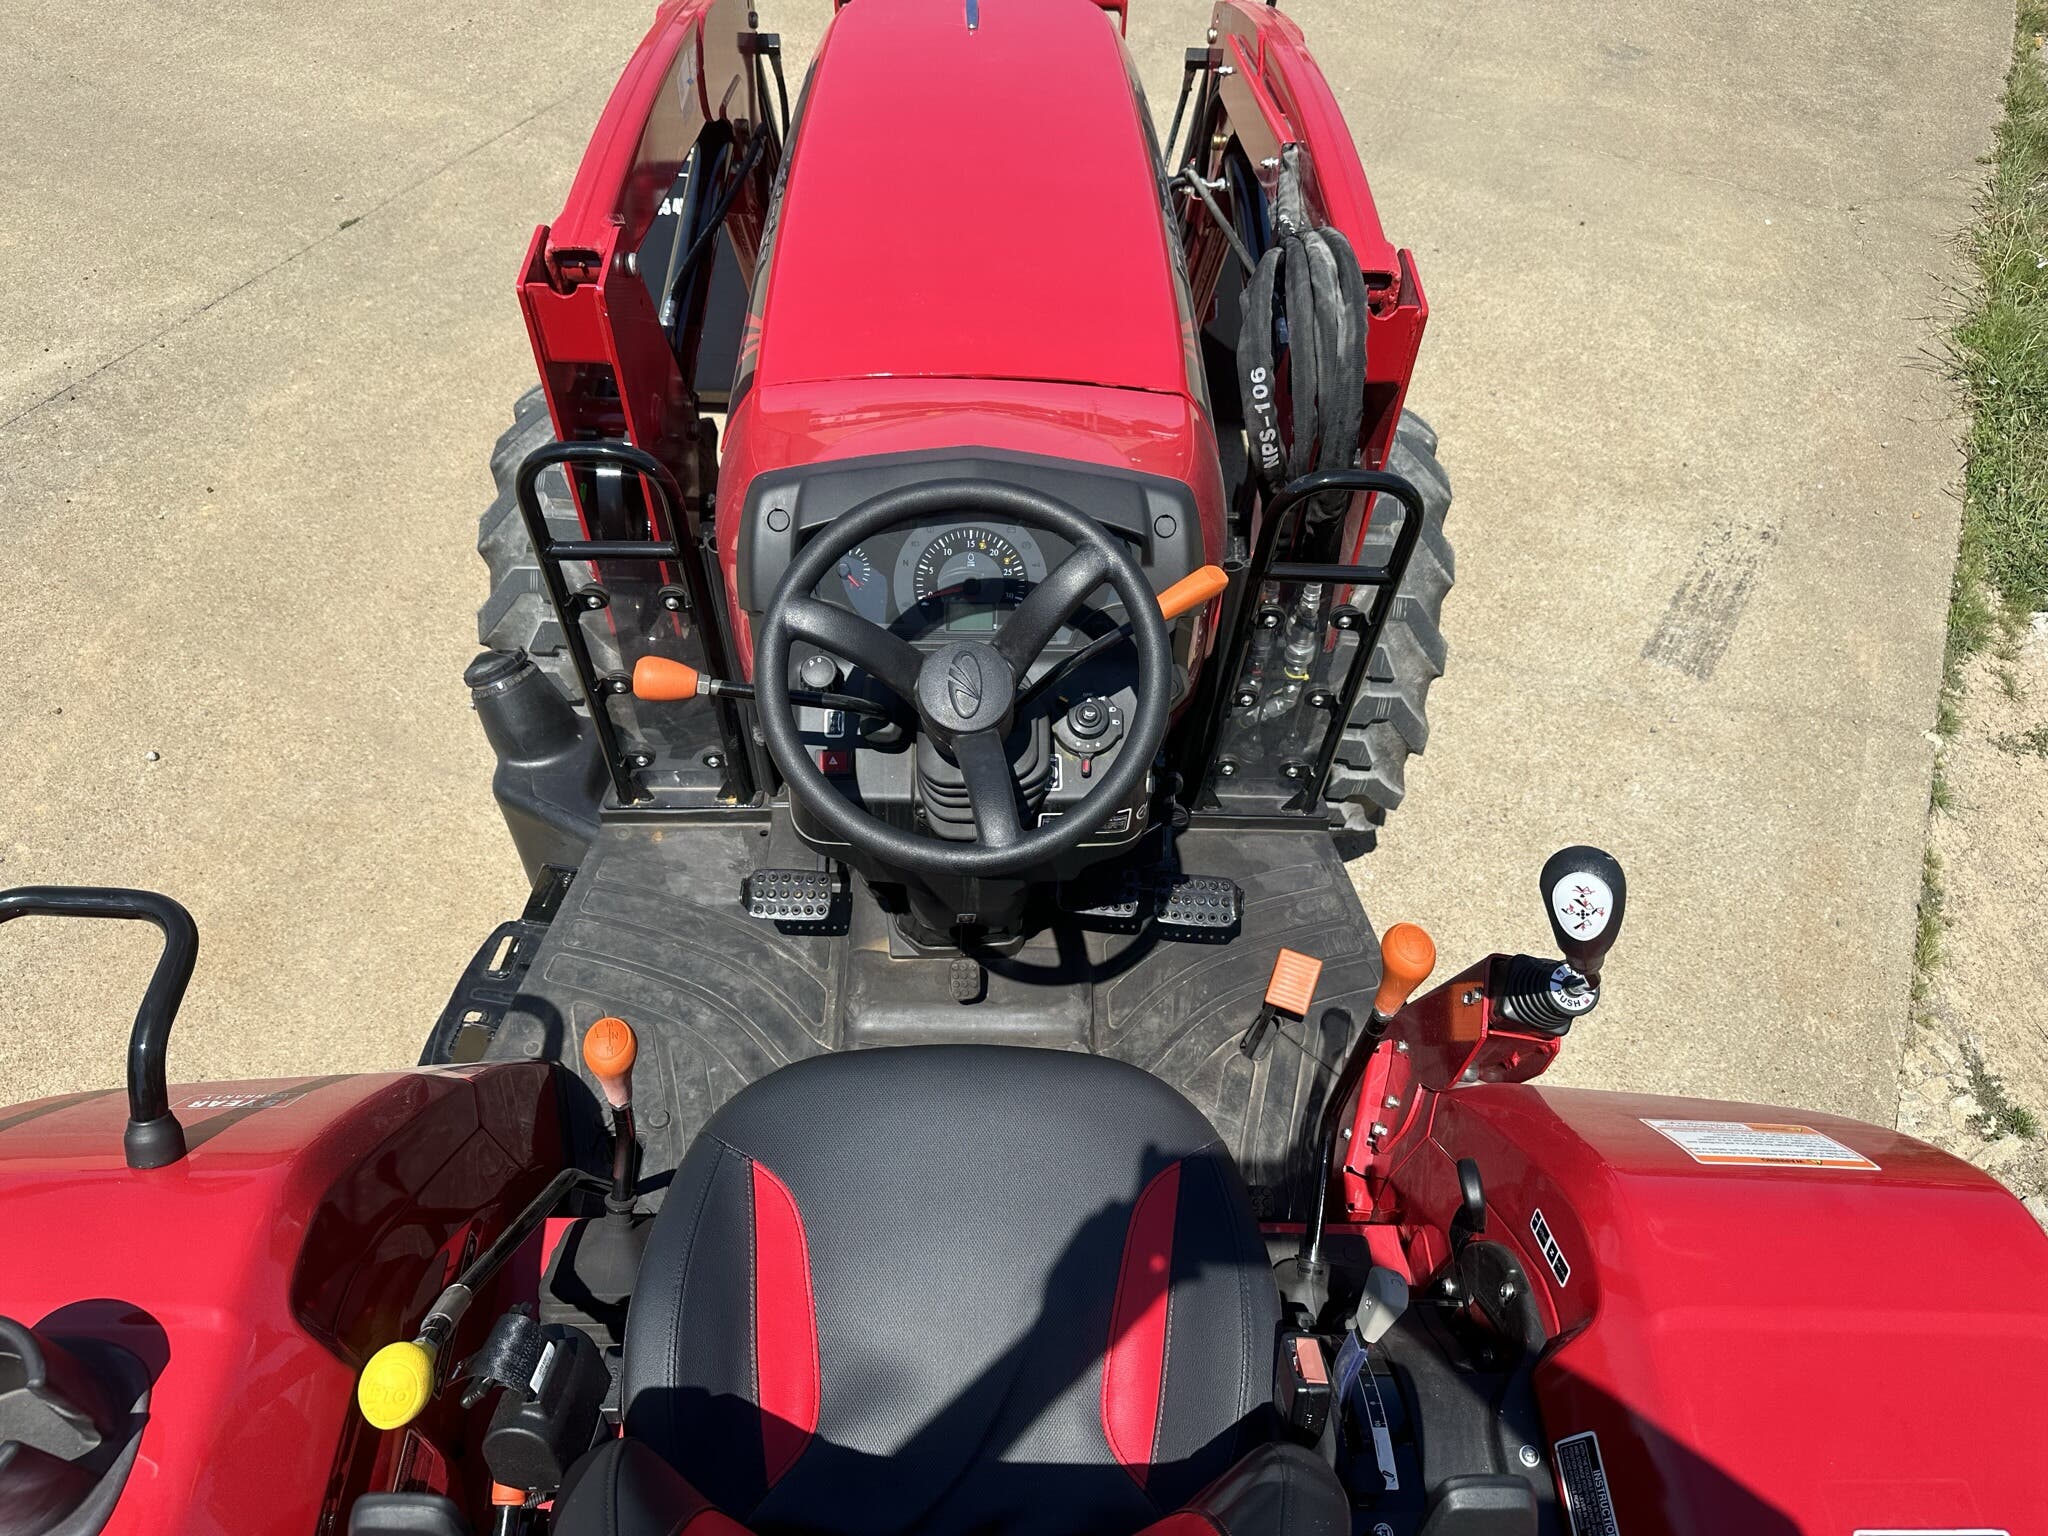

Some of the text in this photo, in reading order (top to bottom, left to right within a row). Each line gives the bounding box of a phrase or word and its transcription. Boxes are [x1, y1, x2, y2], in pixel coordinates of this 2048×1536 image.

[1251, 367, 1280, 469] NPS-106
[967, 540, 975, 548] 15
[943, 548, 953, 556] 10
[1556, 990, 1581, 1008] PUSH
[188, 1099, 256, 1108] YEAR
